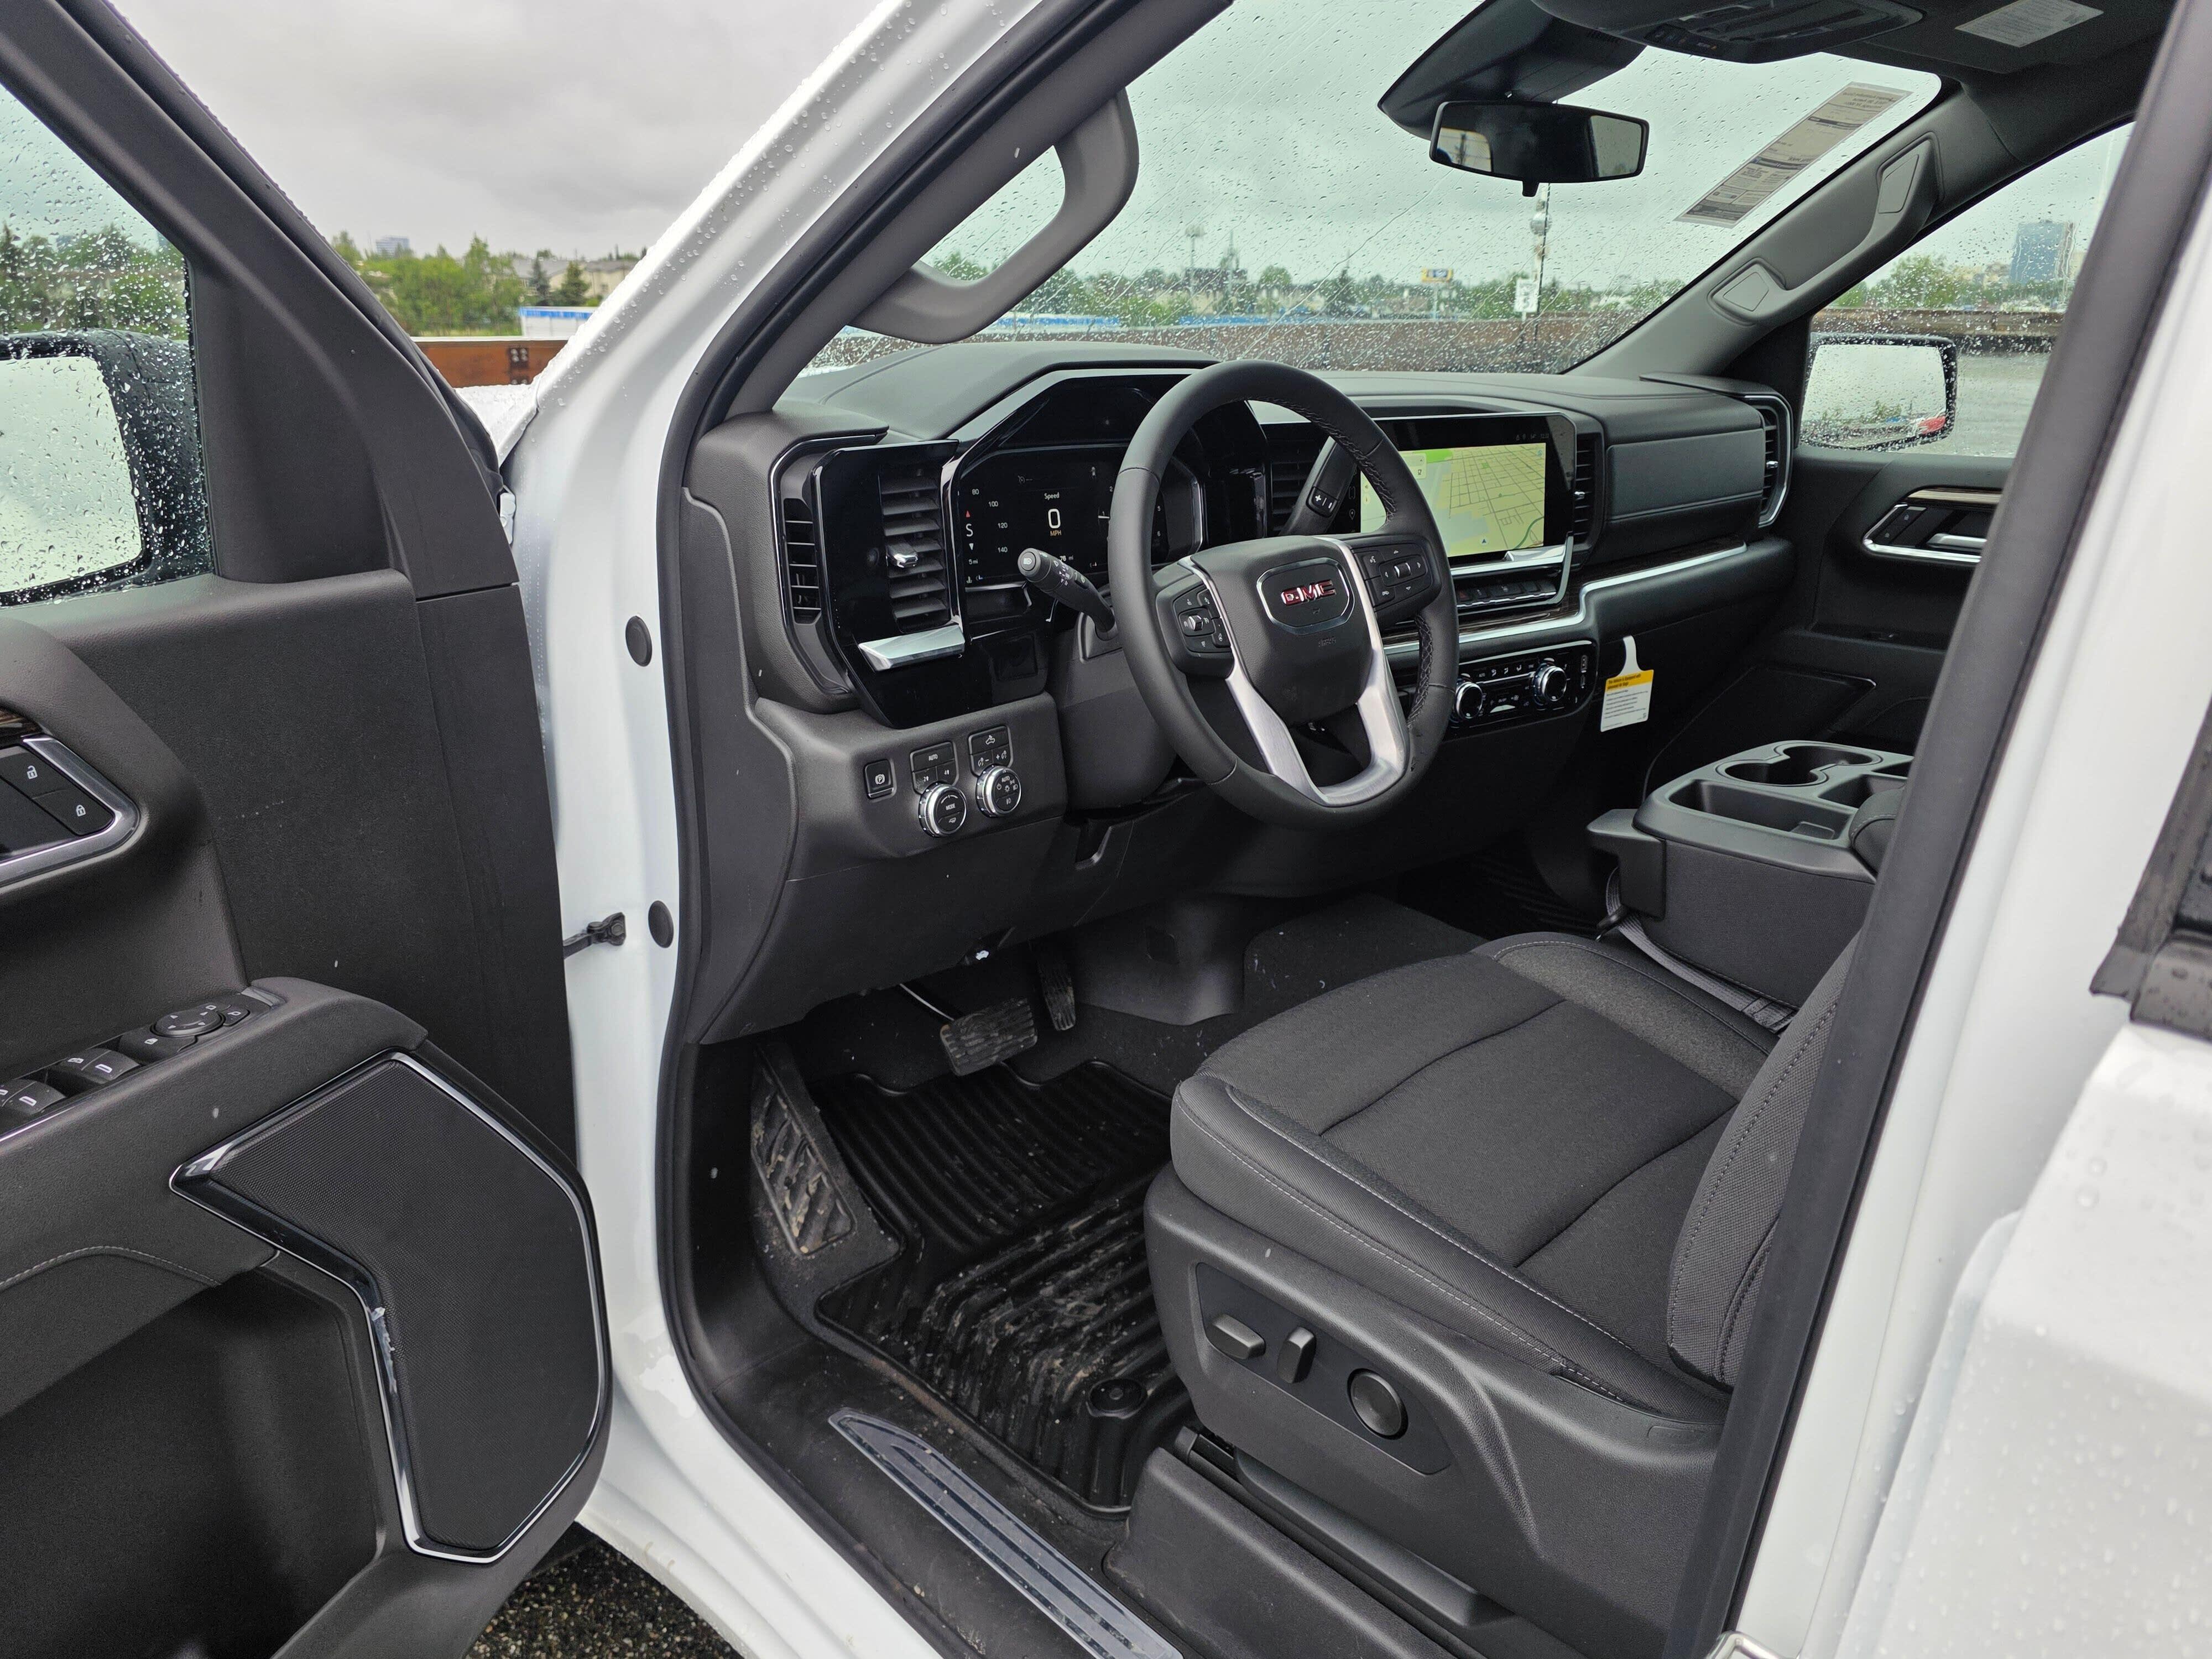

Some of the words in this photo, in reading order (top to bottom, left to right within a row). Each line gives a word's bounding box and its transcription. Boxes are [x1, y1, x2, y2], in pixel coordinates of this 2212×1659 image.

[1044, 492, 1060, 500] Speed
[1048, 508, 1061, 529] 0
[966, 523, 973, 537] S
[1281, 580, 1337, 606] GMC
